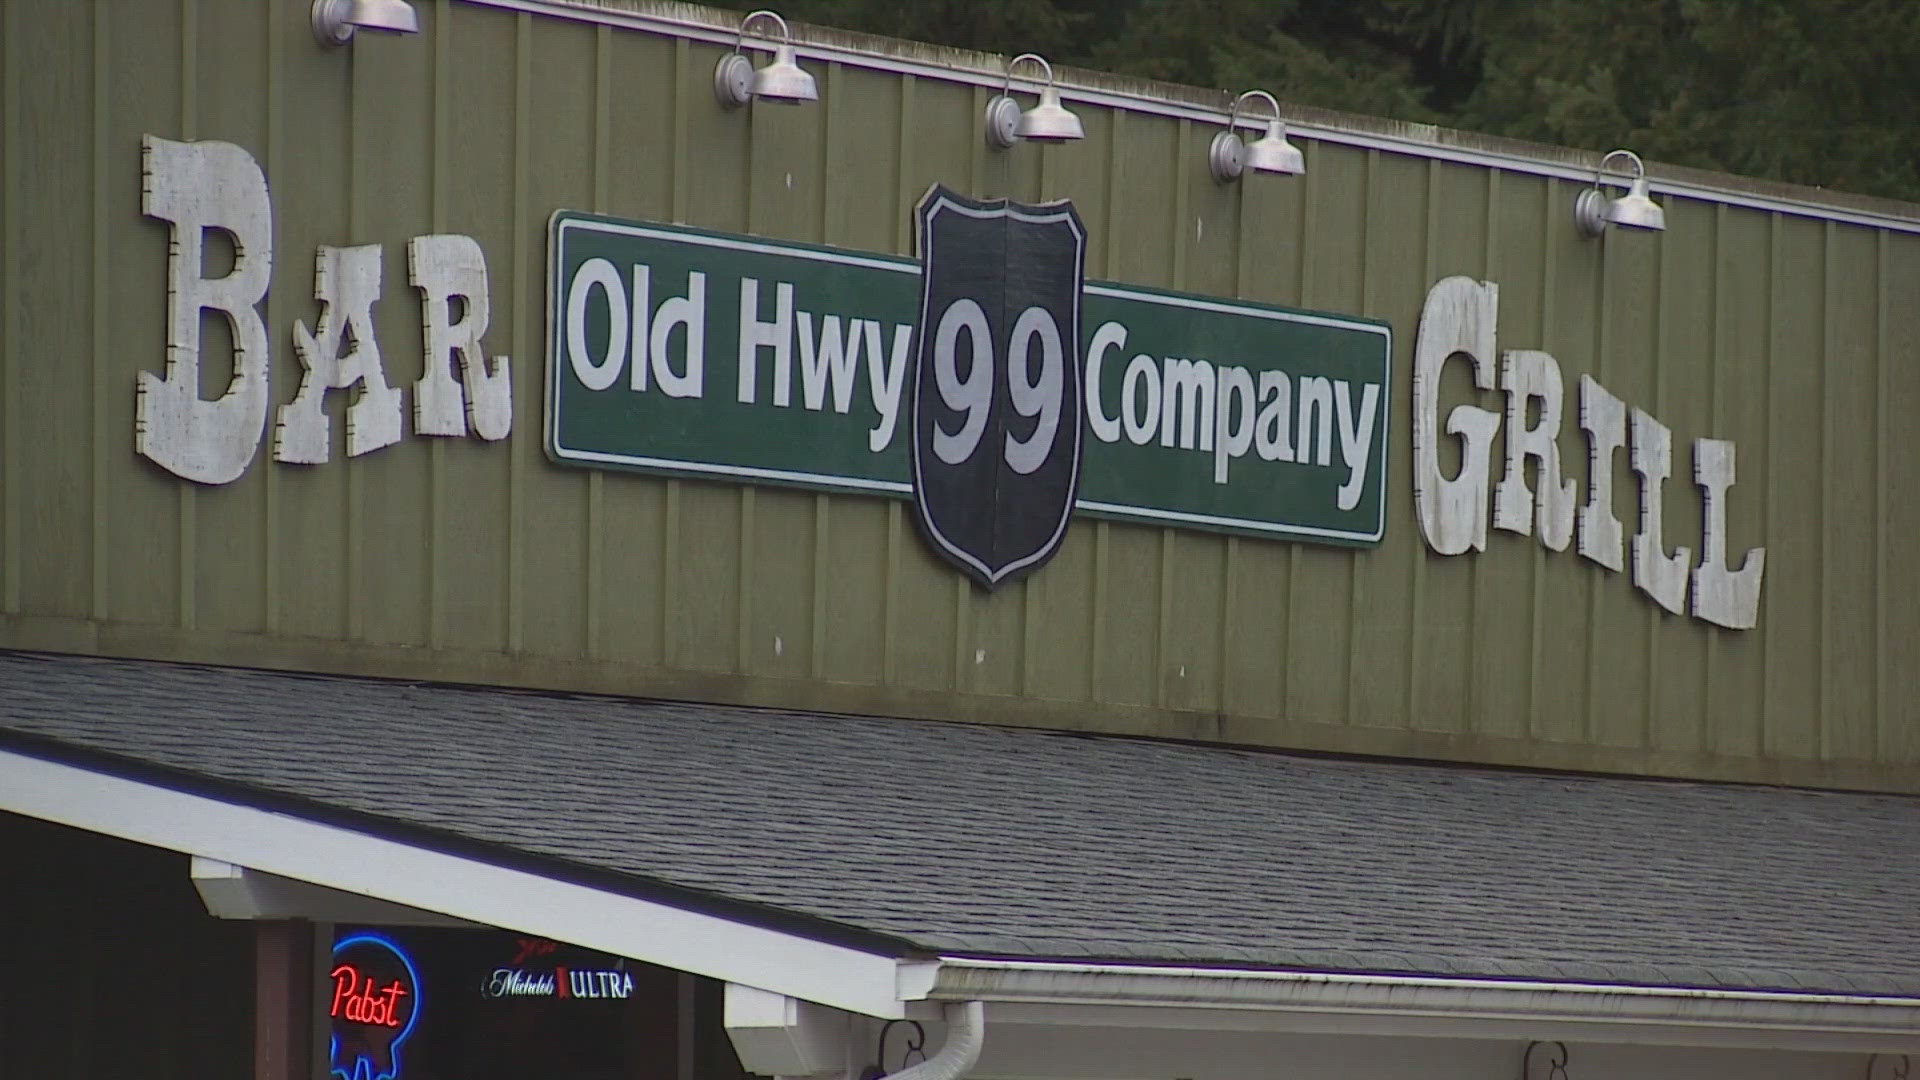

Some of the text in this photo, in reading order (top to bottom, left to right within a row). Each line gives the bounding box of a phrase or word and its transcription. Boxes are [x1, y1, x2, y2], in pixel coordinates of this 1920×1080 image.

[136, 134, 512, 485] BAR
[567, 257, 1381, 511] Old Hwy 99 Company
[1413, 276, 1766, 631] GRILL
[331, 965, 408, 1026] Pabst
[569, 969, 633, 998] ULTRA
